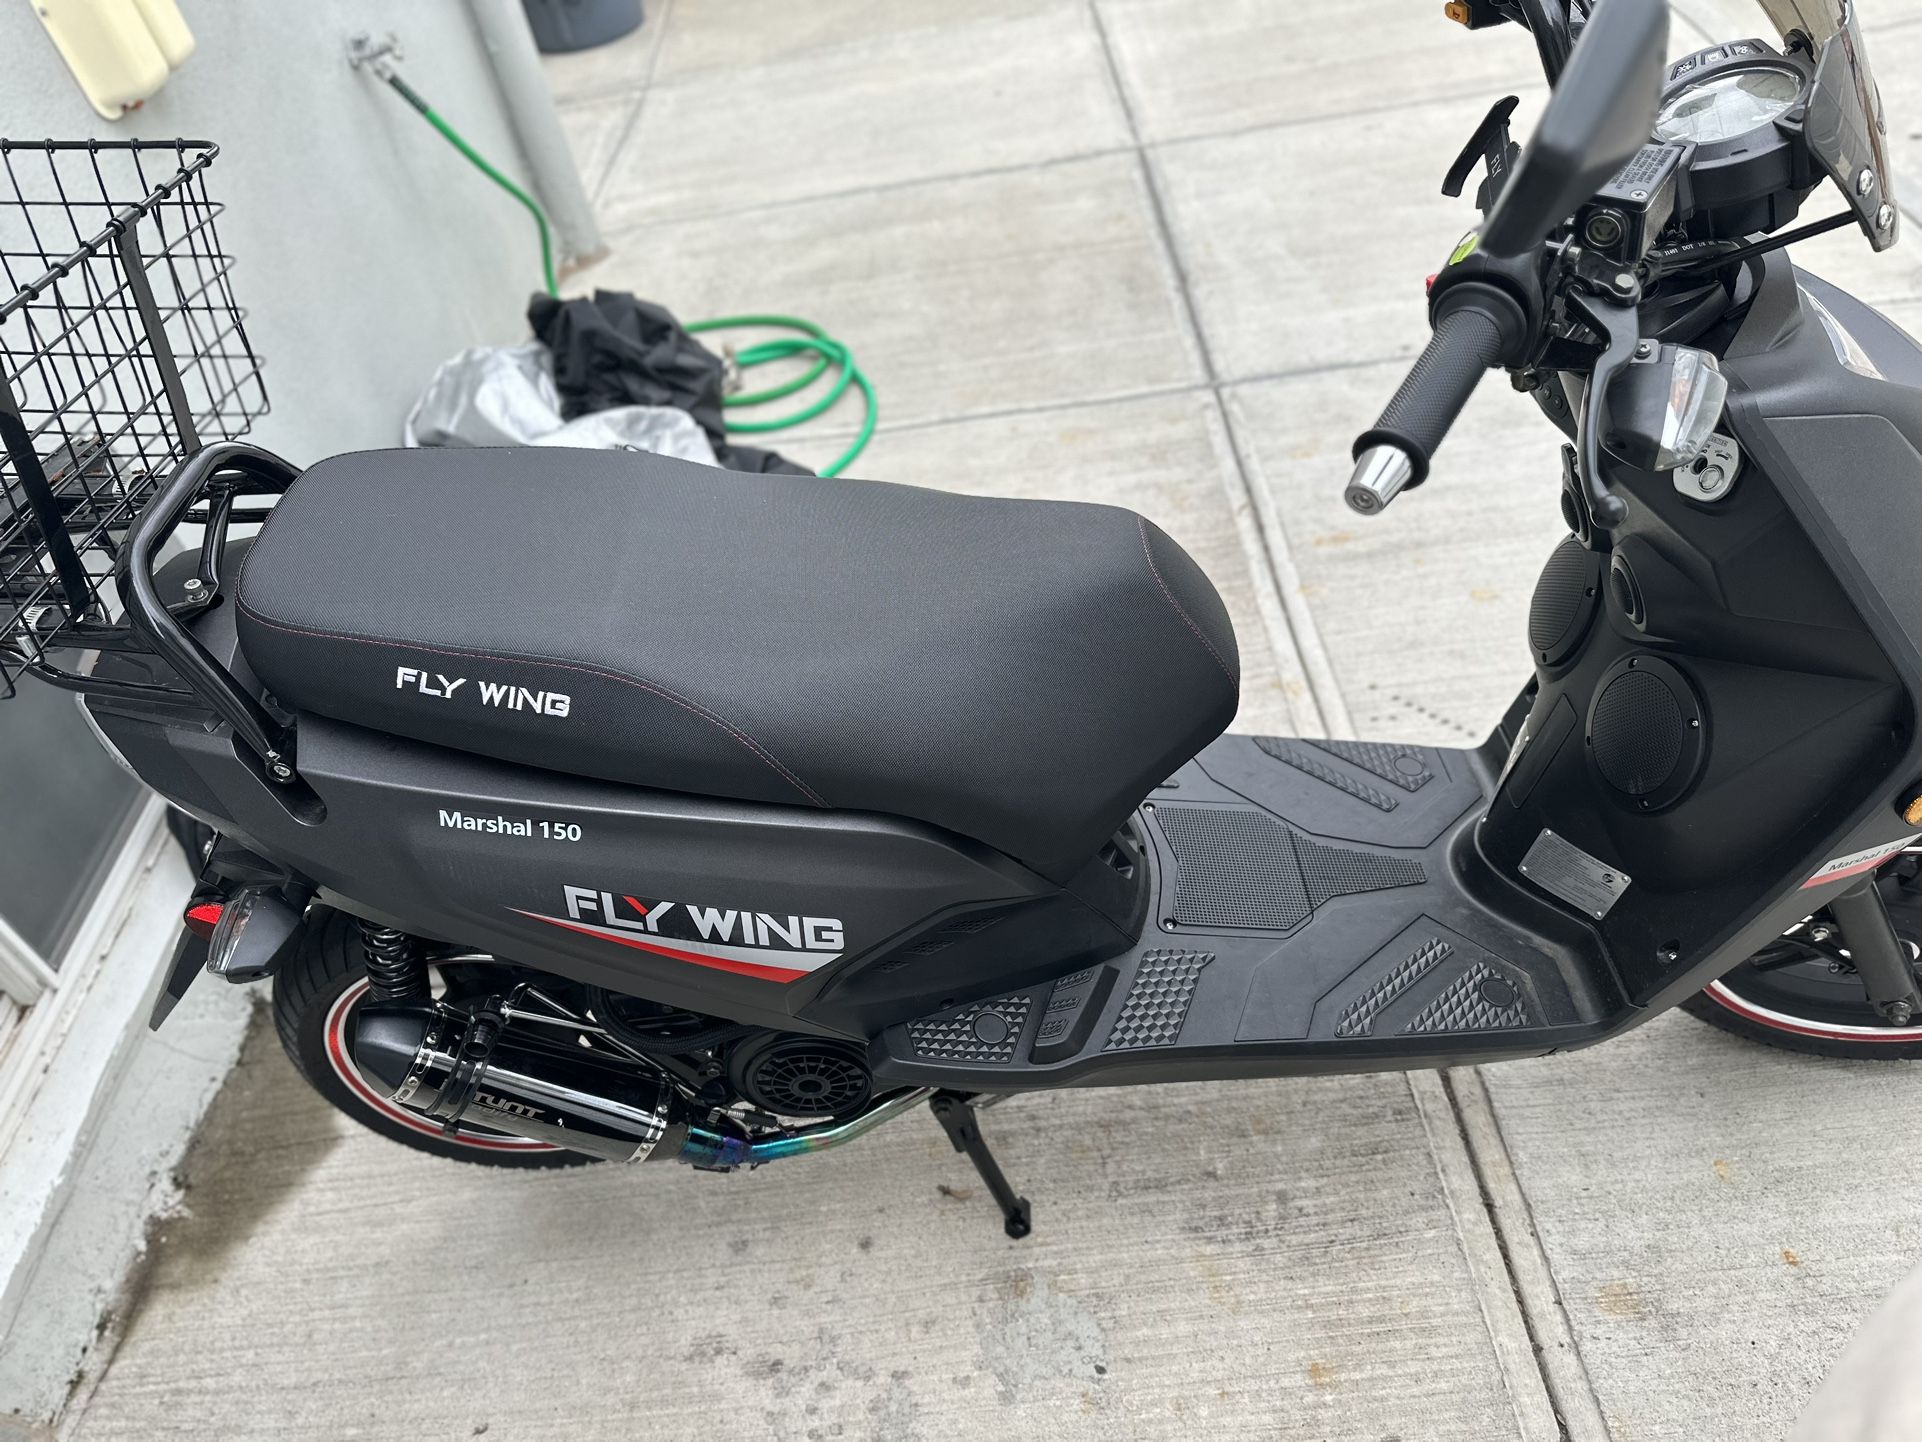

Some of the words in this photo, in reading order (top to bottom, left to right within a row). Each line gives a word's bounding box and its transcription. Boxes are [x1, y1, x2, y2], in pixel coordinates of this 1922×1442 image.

[1490, 154, 1502, 178] FLY
[396, 666, 466, 698] FLY
[479, 681, 571, 717] WING
[438, 809, 532, 838] Marshal
[539, 821, 582, 842] 150
[1828, 852, 1880, 872] Marshal
[563, 885, 675, 932] FLY
[686, 905, 845, 951] WING
